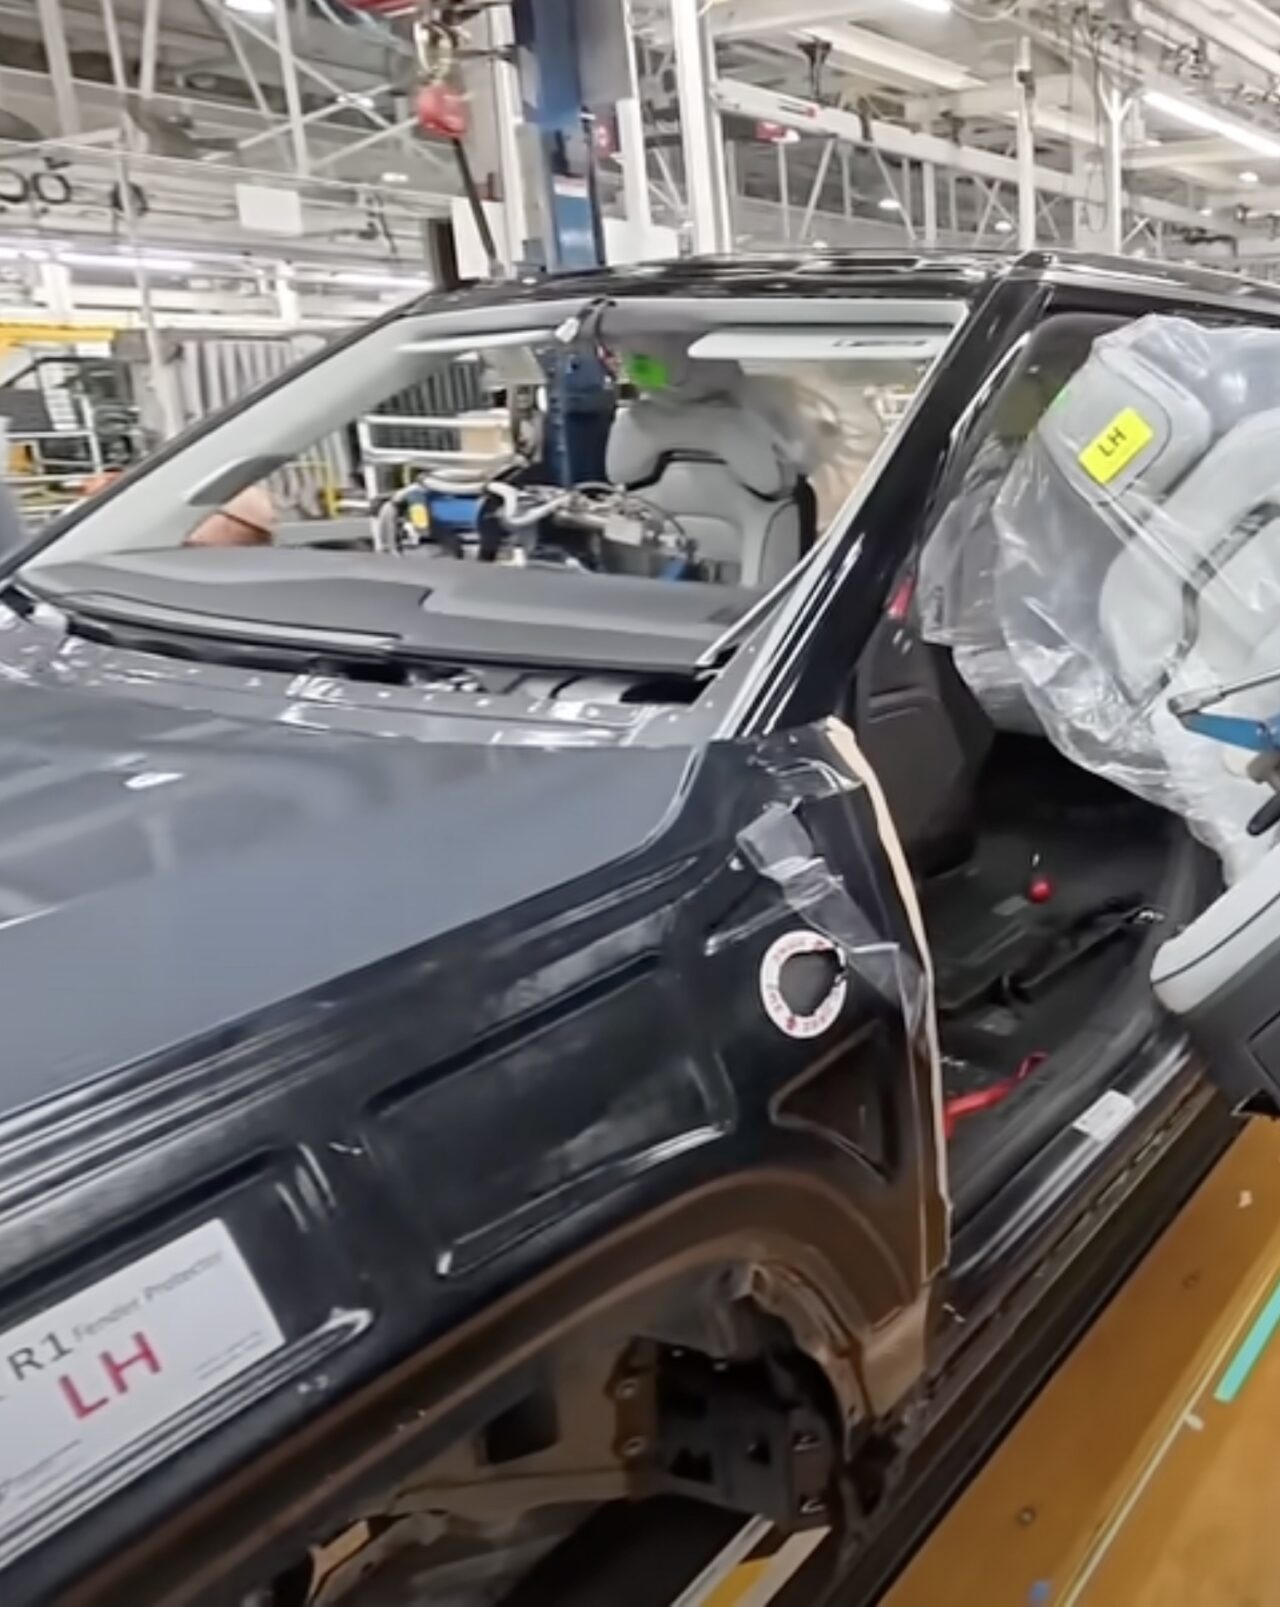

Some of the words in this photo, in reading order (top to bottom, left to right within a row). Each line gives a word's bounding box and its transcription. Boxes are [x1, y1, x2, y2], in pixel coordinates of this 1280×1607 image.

[1098, 426, 1128, 457] LH
[7, 1333, 73, 1381] R1
[58, 1331, 161, 1420] LH
